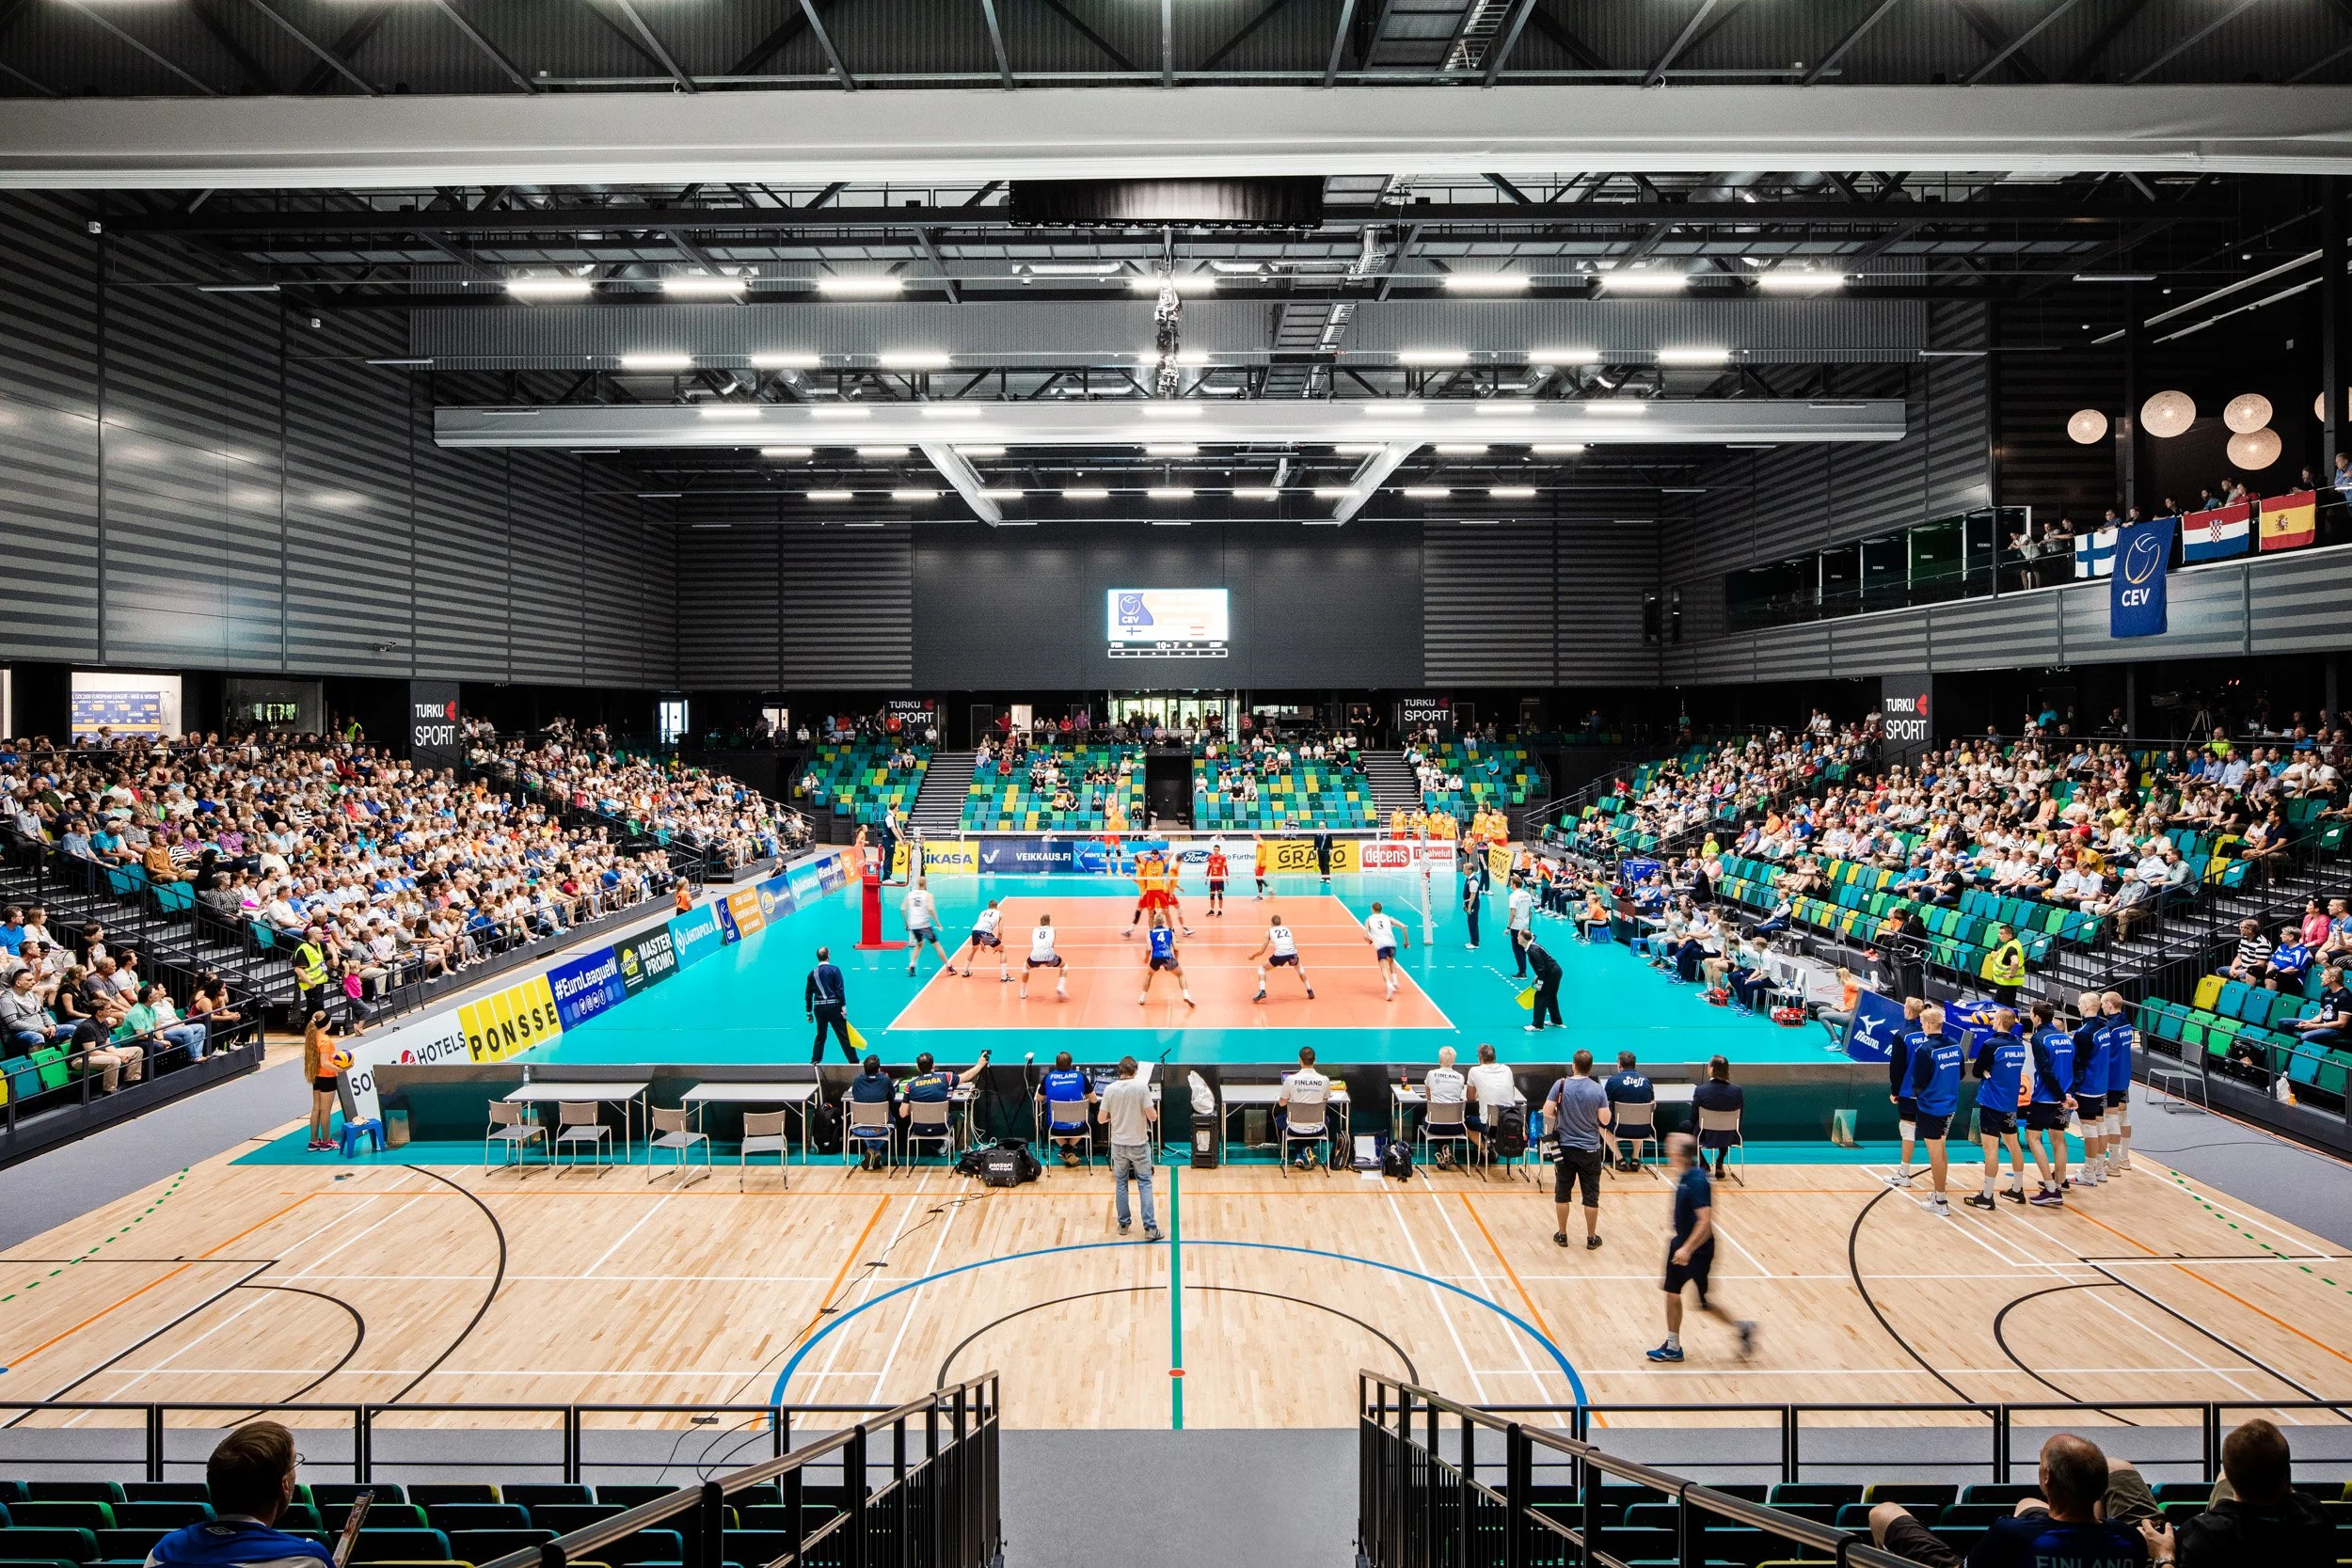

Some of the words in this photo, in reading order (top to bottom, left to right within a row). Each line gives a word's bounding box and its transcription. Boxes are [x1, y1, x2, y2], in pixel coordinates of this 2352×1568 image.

[2122, 588, 2151, 607] CEV
[415, 704, 444, 718] TURKU
[1885, 698, 1915, 712] TURKU
[1405, 710, 1449, 721] SPORT
[415, 725, 455, 746] SPORT
[1885, 720, 1927, 740] SPORT
[913, 851, 973, 864] IKASA
[1016, 852, 1072, 862] VEIKKAUS.FI
[1184, 851, 1209, 863] Ford
[1279, 849, 1346, 863] GRAO
[1365, 847, 1407, 863] decens
[1039, 930, 1046, 939] 8
[1156, 931, 1166, 942] 4
[1275, 928, 1291, 939] 22
[638, 932, 673, 960] MASTER
[645, 950, 675, 976] PROMO
[555, 957, 618, 1001] #EuroLeagueW
[469, 1002, 557, 1061] PONSSE
[417, 1031, 467, 1064] HOTELS
[915, 1076, 942, 1087] ESPAÑA
[1622, 1076, 1645, 1087] Staff
